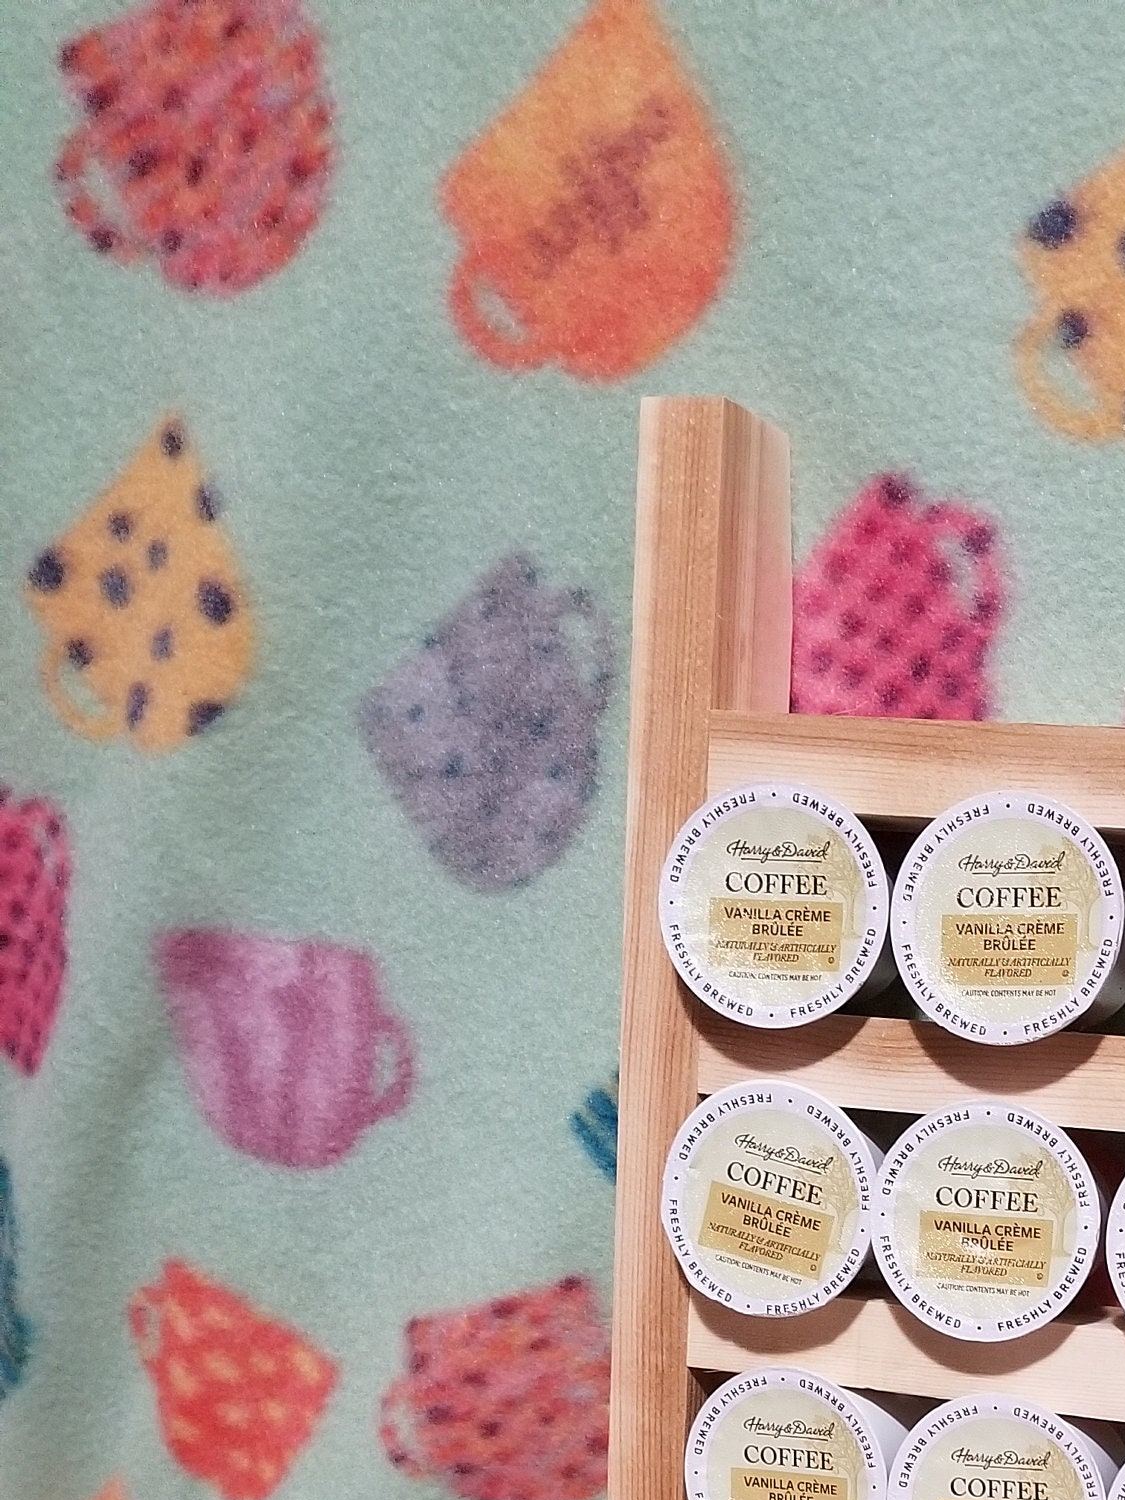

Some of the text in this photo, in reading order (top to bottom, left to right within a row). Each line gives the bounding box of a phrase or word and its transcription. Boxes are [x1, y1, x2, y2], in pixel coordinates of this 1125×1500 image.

[725, 872, 828, 896] COFFEE
[956, 886, 1062, 909] COFFEE
[724, 906, 782, 921] VANILLA
[955, 923, 1014, 936] VANILLA
[669, 924, 753, 1017] FRESHLY BREWED
[790, 928, 876, 1018] FRESHLY BREWED
[1024, 939, 1113, 1035] FRESHLY BREWED
[726, 1161, 822, 1206] COFFEE
[721, 1192, 820, 1232] VANILLA CRÈME
[935, 1186, 1039, 1213] COFFEE
[742, 1214, 792, 1238] BRÛLÉE
[933, 1219, 1041, 1239] VANILLA CRÈME
[670, 1198, 732, 1302] FRESHLY BREWED
[738, 1241, 783, 1261] FLAVORED
[998, 1247, 1087, 1332] FRESHLY BREWED
[744, 1444, 834, 1471] COFFEE
[899, 1405, 978, 1488] FRESHLY BREWED
[744, 1475, 838, 1496] VANILLA CRÈME
